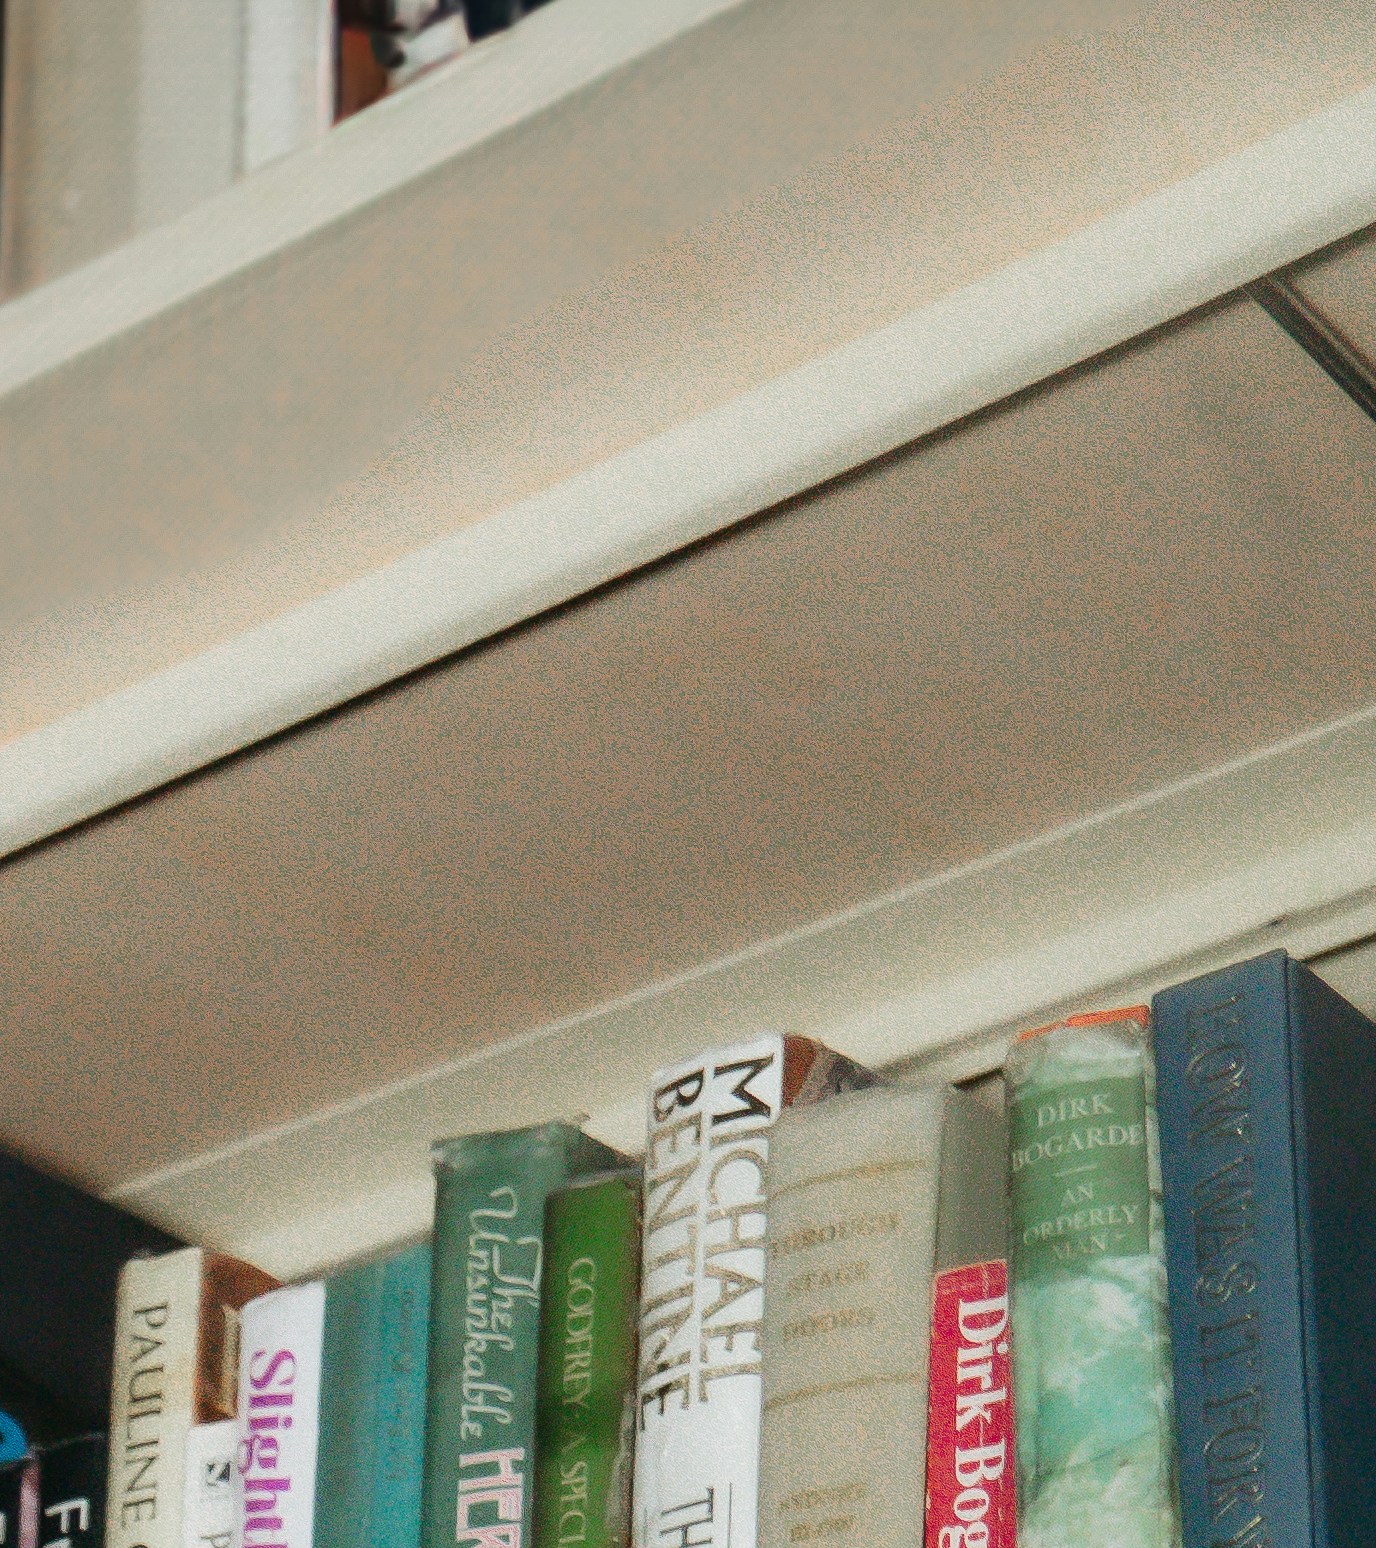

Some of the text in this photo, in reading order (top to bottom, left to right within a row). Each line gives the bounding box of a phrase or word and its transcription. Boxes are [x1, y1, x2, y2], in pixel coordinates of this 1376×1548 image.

[1037, 1094, 1114, 1128] DIRK
[1186, 992, 1250, 1142] HOW
[1013, 1124, 1145, 1173] BOGARDE
[1061, 1184, 1095, 1207] AN
[640, 1065, 705, 1432] BENTINE
[698, 1052, 776, 1405] MICHAEL
[1023, 1204, 1140, 1244] ORDERLY
[1052, 1233, 1110, 1258] MAN
[1191, 1155, 1259, 1303] WAS
[460, 1185, 519, 1440] Unsinkable
[491, 1235, 543, 1328] The
[955, 1296, 1010, 1432] Dirk
[1200, 1312, 1258, 1370] IT
[120, 1303, 169, 1529] PAULINE
[562, 1434, 587, 1456] A
[1203, 1383, 1266, 1520] FOR
